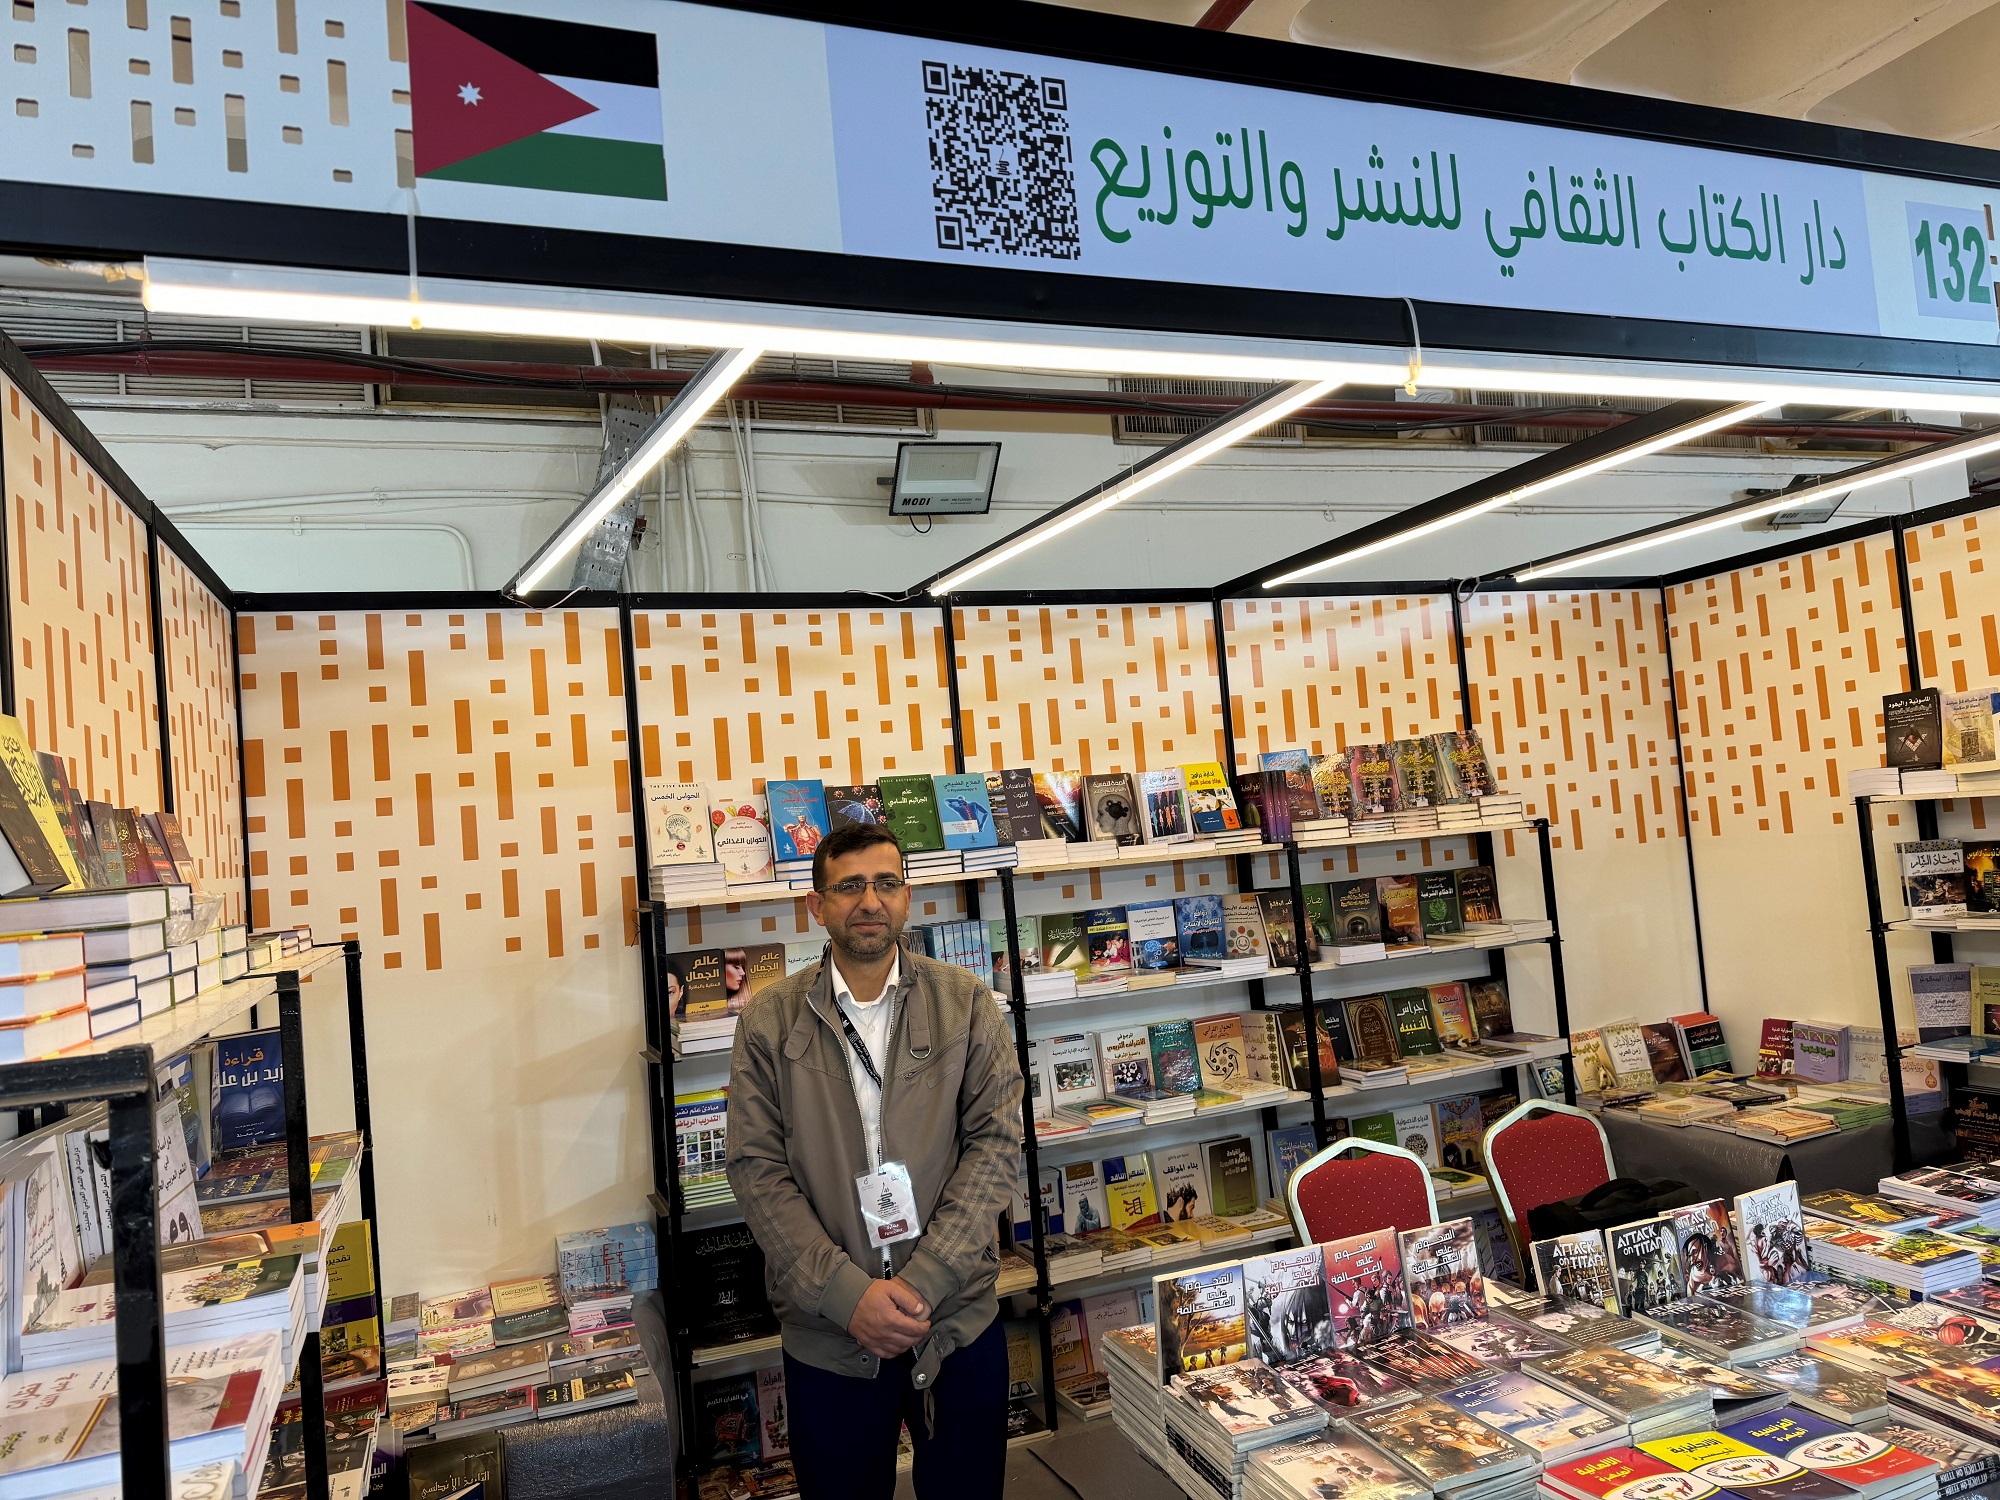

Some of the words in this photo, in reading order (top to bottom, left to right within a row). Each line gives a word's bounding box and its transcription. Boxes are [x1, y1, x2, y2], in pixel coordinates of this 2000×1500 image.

[1090, 125, 1308, 244] والتوزيع
[1326, 144, 1462, 241] للنشر
[1484, 165, 1641, 278] الثقافي
[1657, 184, 1787, 273] الكتاب
[1799, 199, 1847, 286] دار
[1914, 219, 1992, 305] 132
[902, 497, 931, 506] MODI
[651, 793, 675, 802] الخمس
[692, 955, 719, 970] عالم
[759, 952, 780, 964] عالم
[685, 968, 720, 983] الجمال
[750, 962, 779, 974] الجمال
[1400, 1015, 1433, 1036] التنبيه
[224, 1047, 265, 1067] قراءة
[219, 1071, 238, 1088] عل
[242, 1069, 259, 1087] بن
[263, 1064, 284, 1082] زيد
[689, 1107, 702, 1116] علم
[700, 1115, 721, 1126] التدريب
[676, 1118, 698, 1129] الرياض
[75, 1163, 84, 1174] في
[177, 1162, 188, 1179] الشعر
[1162, 1164, 1186, 1175] المواقف
[1187, 1162, 1199, 1171] بناء
[76, 1175, 87, 1191] الشعر
[100, 1173, 109, 1189] الشعر
[165, 1170, 180, 1190] العربي
[79, 1190, 91, 1210] العربي
[102, 1189, 112, 1209] العربي
[1746, 1193, 1785, 1220] ATTACK
[83, 1210, 91, 1232] الحديث
[1674, 1207, 1710, 1231] ATTACK
[1763, 1204, 1791, 1225] TITAN
[1617, 1224, 1658, 1250] ATTACK
[1689, 1221, 1720, 1235] TITAN
[1415, 1229, 1456, 1252] الهجوم
[1552, 1239, 1597, 1258] ATTACK
[1623, 1246, 1634, 1256] on
[1633, 1236, 1664, 1257] TITAN
[1334, 1239, 1377, 1262] الهجوم
[1436, 1245, 1453, 1257] على
[1271, 1252, 1317, 1273] الهجوم
[1356, 1255, 1374, 1267] على
[1412, 1251, 1462, 1274] العمالقة
[1559, 1257, 1570, 1266] on
[1570, 1255, 1604, 1269] TITAN
[1292, 1269, 1312, 1281] على
[1331, 1261, 1383, 1284] العمالقة
[1185, 1272, 1233, 1294] الهجوم
[1264, 1276, 1320, 1295] العمالقة
[1207, 1288, 1228, 1301] على
[1176, 1296, 1236, 1316] العمالقة
[1455, 1380, 1502, 1399] الهجوم
[1463, 1386, 1523, 1408] العمالقة
[1479, 1388, 1498, 1397] على
[1364, 1403, 1415, 1422] الهجوم
[1390, 1412, 1409, 1422] على
[1369, 1411, 1432, 1434] العمالقة
[1747, 1417, 1797, 1438] الفرنسية
[1269, 1434, 1321, 1454] الهجوم
[1291, 1443, 1313, 1454] على
[1271, 1443, 1338, 1465] العمالقة
[1595, 1465, 1634, 1482] الميسرة
[421, 1474, 462, 1499] الأندلسي
